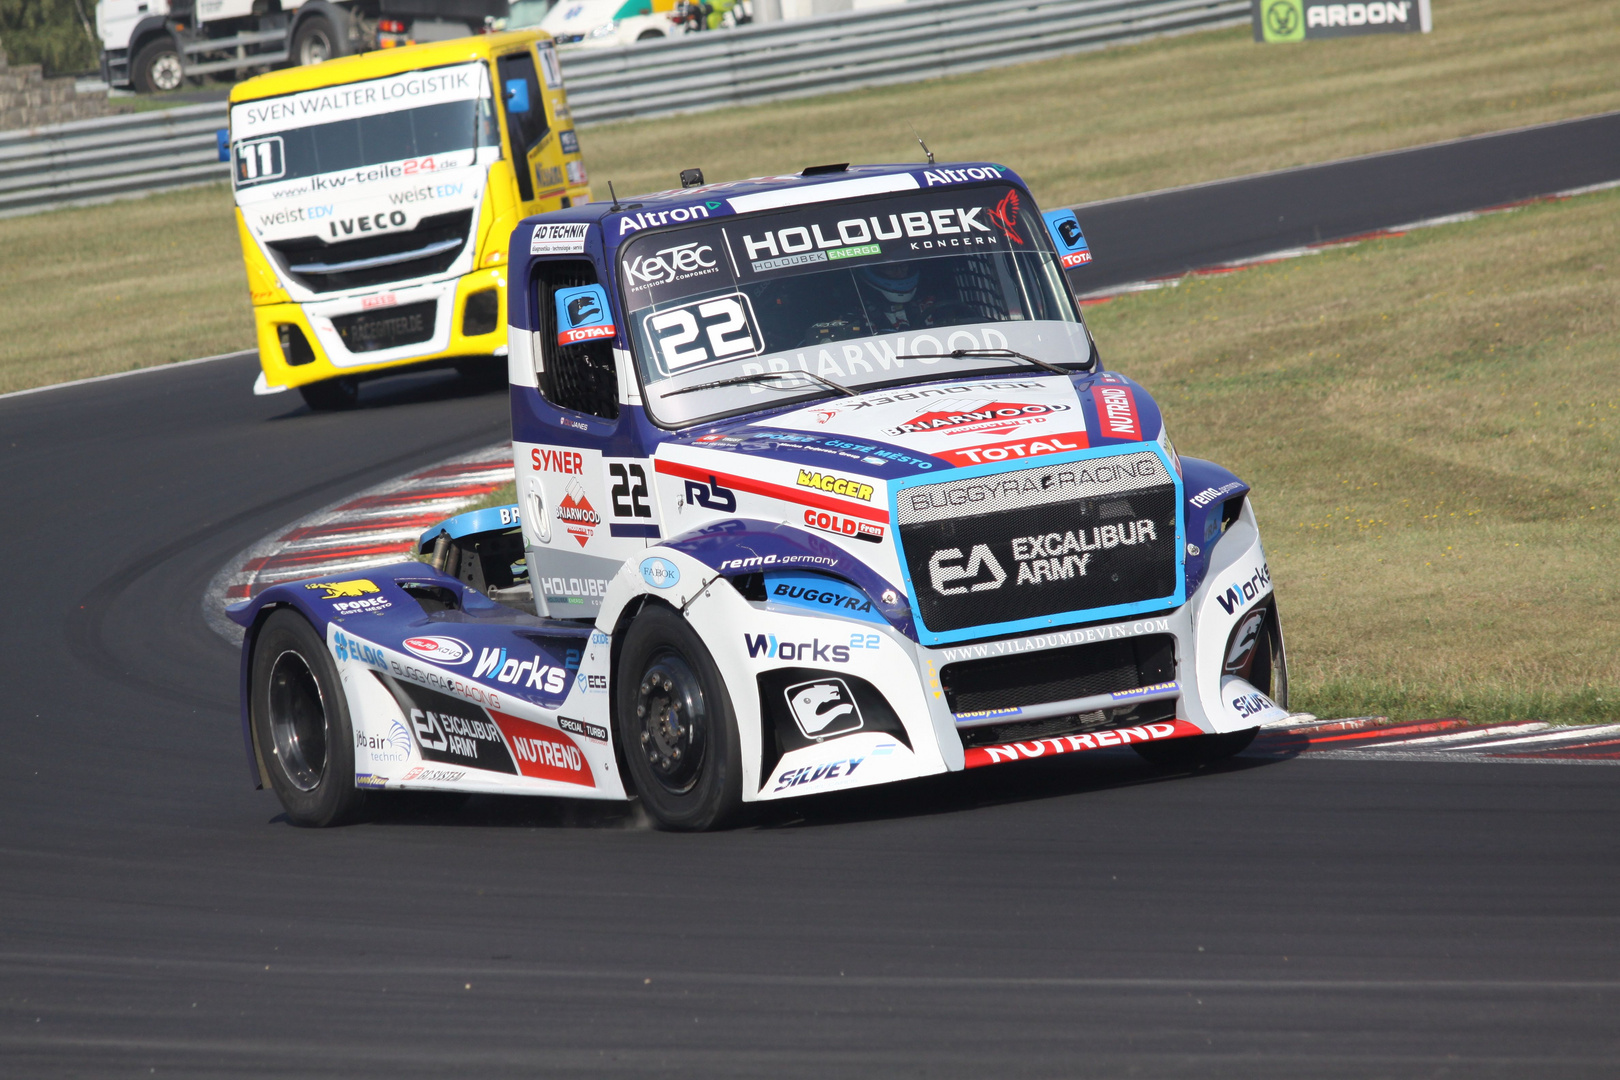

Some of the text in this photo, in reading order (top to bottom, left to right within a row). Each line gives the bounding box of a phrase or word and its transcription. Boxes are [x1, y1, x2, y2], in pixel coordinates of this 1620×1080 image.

[1306, 1, 1408, 28] ARDON
[247, 72, 471, 126] SVEN WALTER LOGISTIK
[239, 142, 273, 179] 11
[272, 155, 458, 200] www.lkw-teile24.de
[923, 165, 1003, 187] Altron
[330, 210, 407, 238] IVECO
[533, 224, 588, 239] AD TECHNIK
[619, 203, 709, 236] Altron
[743, 206, 992, 260] HOLOUBEK
[910, 235, 998, 250] KONCERN
[753, 245, 880, 271] HOLOUBEK ENERGO
[1064, 252, 1092, 265] TOTA
[631, 267, 720, 293] PRECISION COMPONENTS
[567, 326, 615, 341] TOTAL
[651, 298, 755, 370] 22
[741, 327, 1009, 394] BRIARWOOD
[881, 403, 1071, 437] BRIARWOOD
[1101, 388, 1135, 434] NUTREND
[531, 448, 583, 475] SYNER
[955, 438, 1077, 463] TOTAL
[609, 463, 652, 518] 22
[796, 469, 874, 502] BAGGER
[910, 459, 1156, 511] BUGGYRA RACING
[556, 505, 601, 524] BRIARWOOD
[803, 509, 883, 536] GOLD fren
[1011, 519, 1157, 561] EXCALIBUR
[643, 567, 676, 579] FABOK
[720, 554, 839, 571] rema.germany
[1016, 553, 1093, 586] ARMY
[332, 596, 388, 611] IPODEC
[773, 584, 873, 613] BUGGYRA
[1216, 563, 1271, 616] Works
[592, 633, 609, 645] EXIDE
[744, 632, 881, 663] Works 22
[943, 619, 1170, 662] WWW.VILADUMDEVIN.COM
[348, 639, 388, 671] ELDIS
[390, 660, 502, 709] BUGGYRA RACING
[472, 647, 567, 694] Works
[588, 675, 607, 689] ECS
[926, 660, 938, 688] TOW
[1112, 682, 1176, 697] GOODYEAR
[956, 706, 1019, 719] GOODYEAR
[368, 734, 386, 750] air
[443, 713, 500, 743] EXCALIBUR
[560, 718, 606, 739] SPECIAL TURBO
[450, 735, 479, 759] ARMY
[512, 735, 582, 773] NUTREND
[984, 723, 1175, 763] NUTREND
[371, 752, 403, 763] technic
[774, 757, 866, 792] SILVEY
